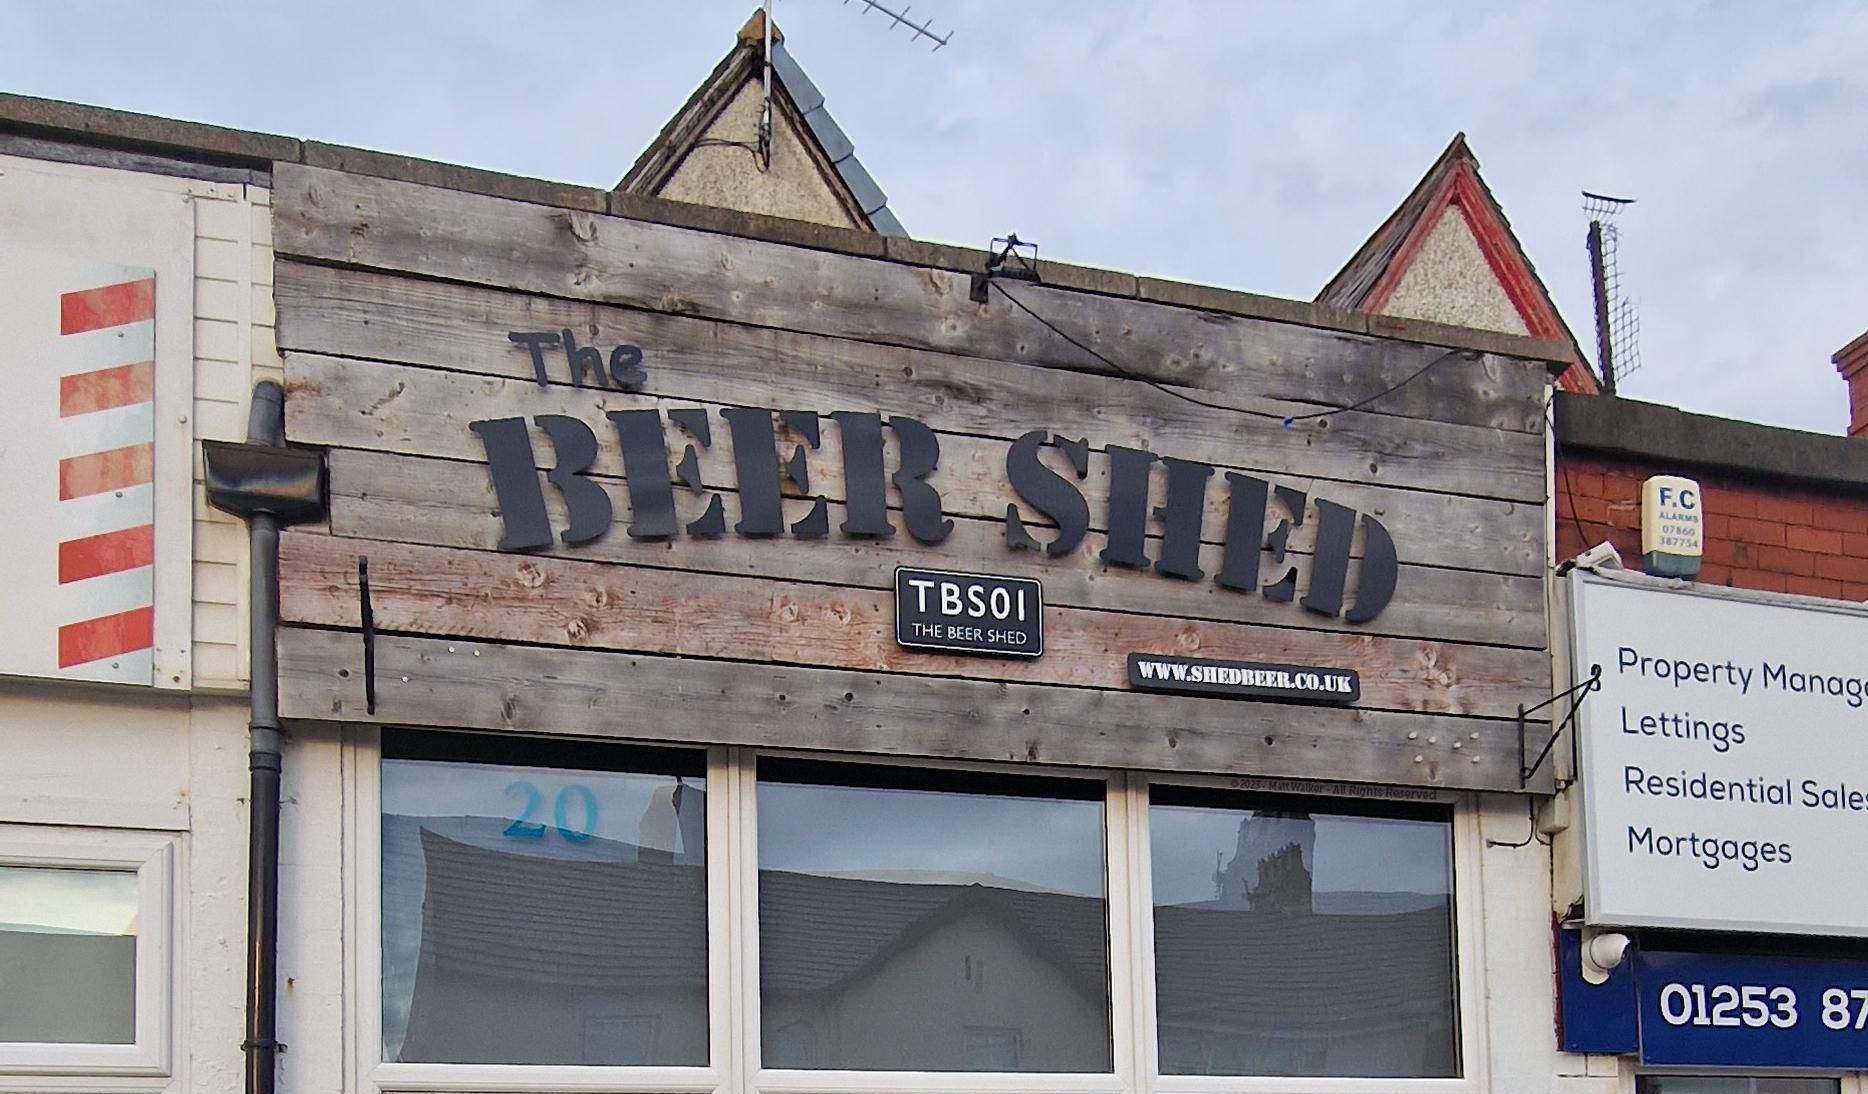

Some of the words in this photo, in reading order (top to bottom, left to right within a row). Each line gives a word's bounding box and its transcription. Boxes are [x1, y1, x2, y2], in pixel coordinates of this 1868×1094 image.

[508, 329, 647, 391] The
[468, 405, 954, 552] BEER
[1005, 428, 1399, 624] SHED
[1659, 487, 1696, 510] F.C
[1659, 512, 1699, 523] ALARMS
[911, 622, 943, 638] THE
[947, 625, 983, 641] BEER
[987, 629, 1027, 645] SHED
[1137, 660, 1353, 693] WWW.SHEDBEER.CO.UK
[1618, 646, 1754, 695] Property
[1762, 661, 1868, 708] Manag
[1621, 707, 1746, 752] Lettings
[1625, 766, 1792, 806] Residential
[1801, 779, 1868, 811] Sale
[503, 780, 599, 844] 20
[1628, 827, 1793, 871] Mortgages
[1659, 983, 1798, 1029] 01253
